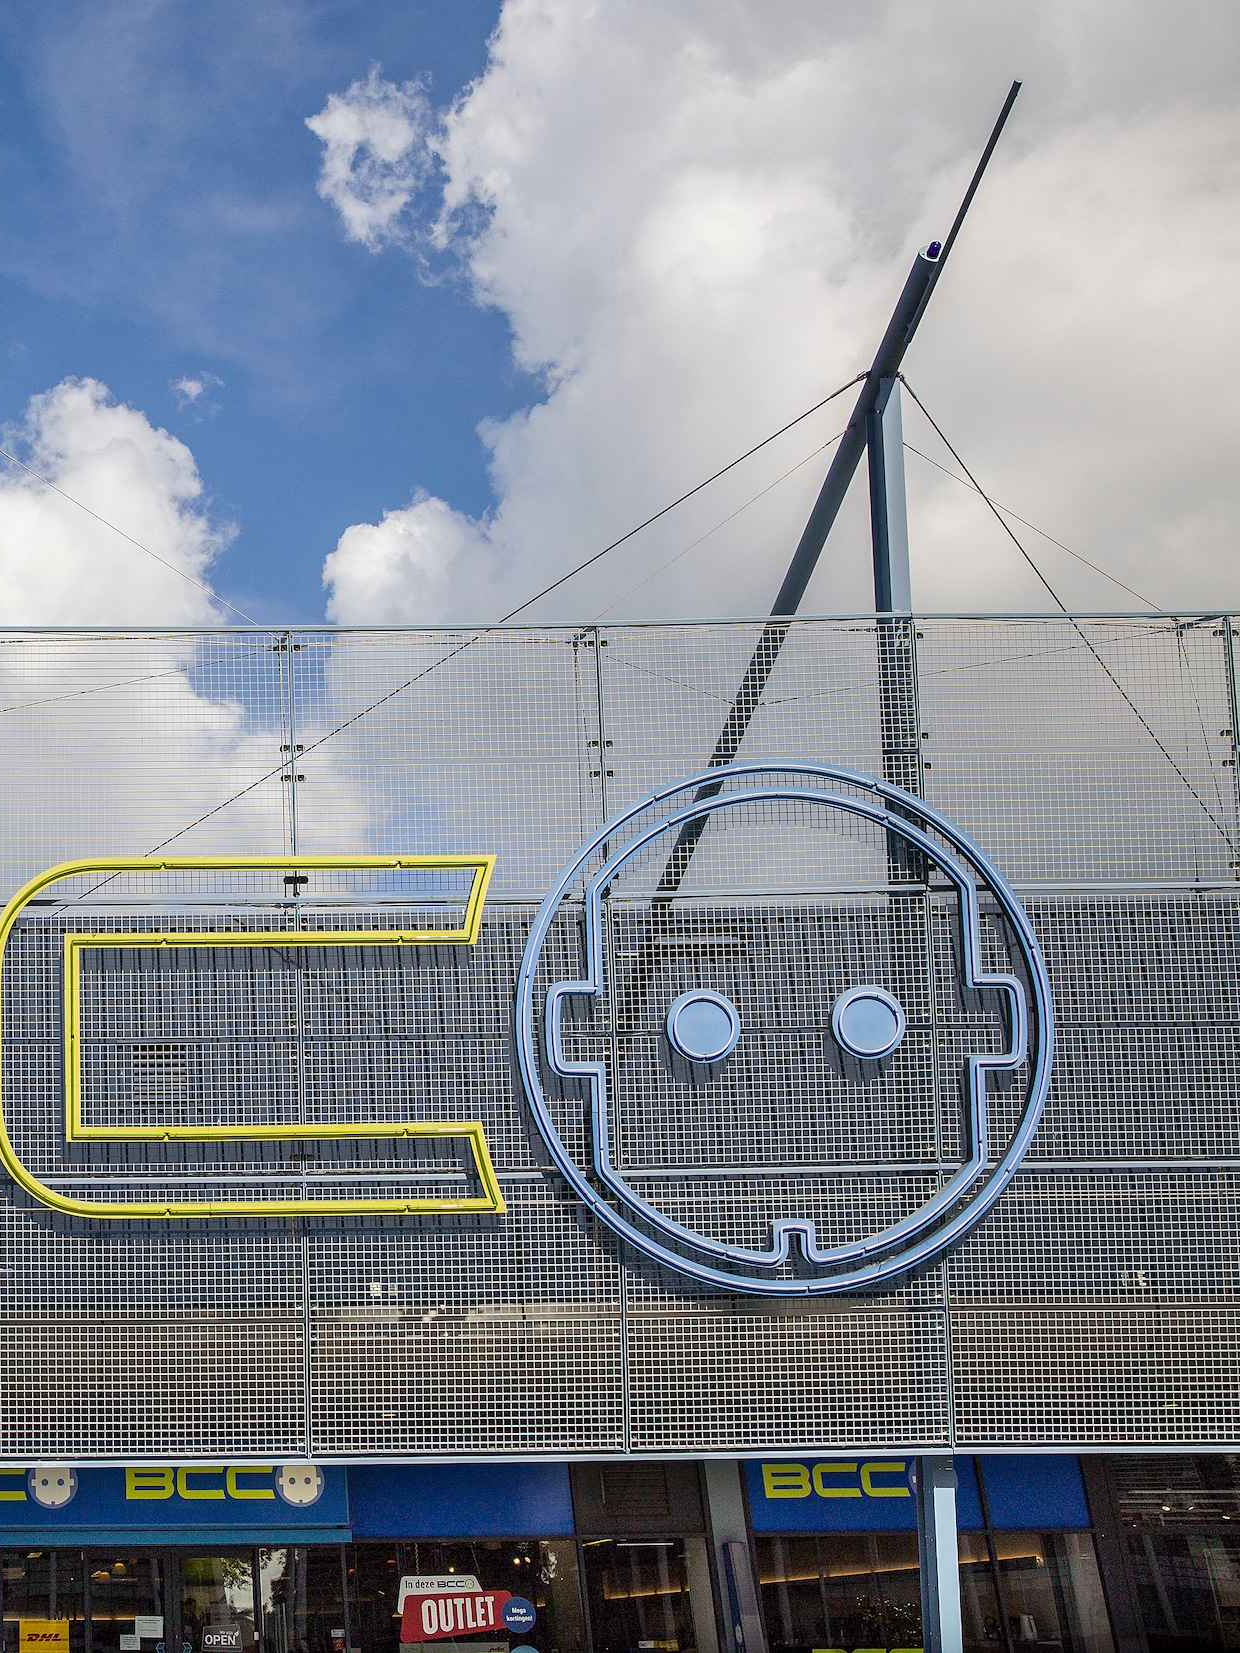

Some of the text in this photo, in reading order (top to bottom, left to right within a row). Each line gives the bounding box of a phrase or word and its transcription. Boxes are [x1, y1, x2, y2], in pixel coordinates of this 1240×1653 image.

[126, 1466, 276, 1500] BCC
[761, 1462, 911, 1499] BCC
[405, 1580, 413, 1589] In
[415, 1580, 435, 1589] deze
[421, 1596, 495, 1635] OUTLET
[27, 1633, 62, 1642] DHL
[204, 1634, 236, 1646] OPEN
